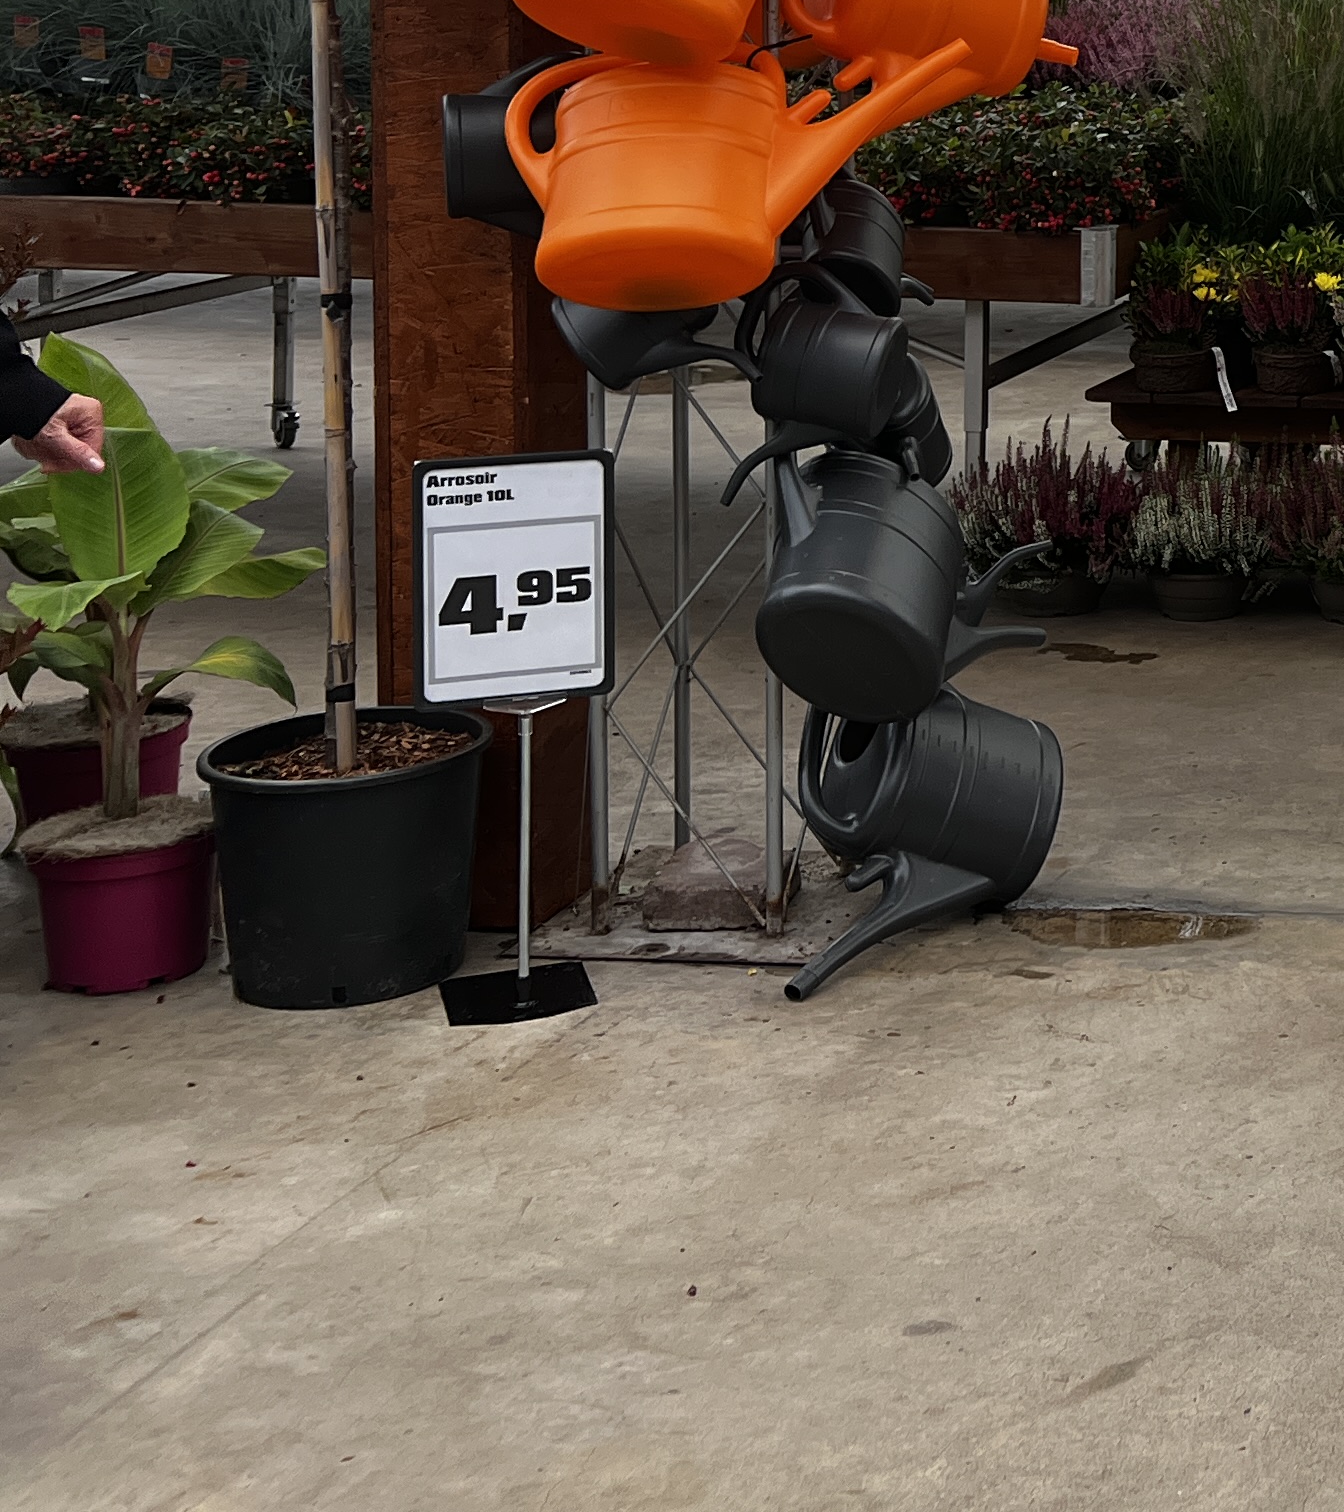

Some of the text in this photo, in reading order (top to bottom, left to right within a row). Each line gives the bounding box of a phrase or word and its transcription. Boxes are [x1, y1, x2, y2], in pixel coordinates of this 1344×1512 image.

[426, 471, 498, 488] Arrosoir
[426, 488, 515, 507] Orange 10L
[438, 566, 592, 636] 4,95
